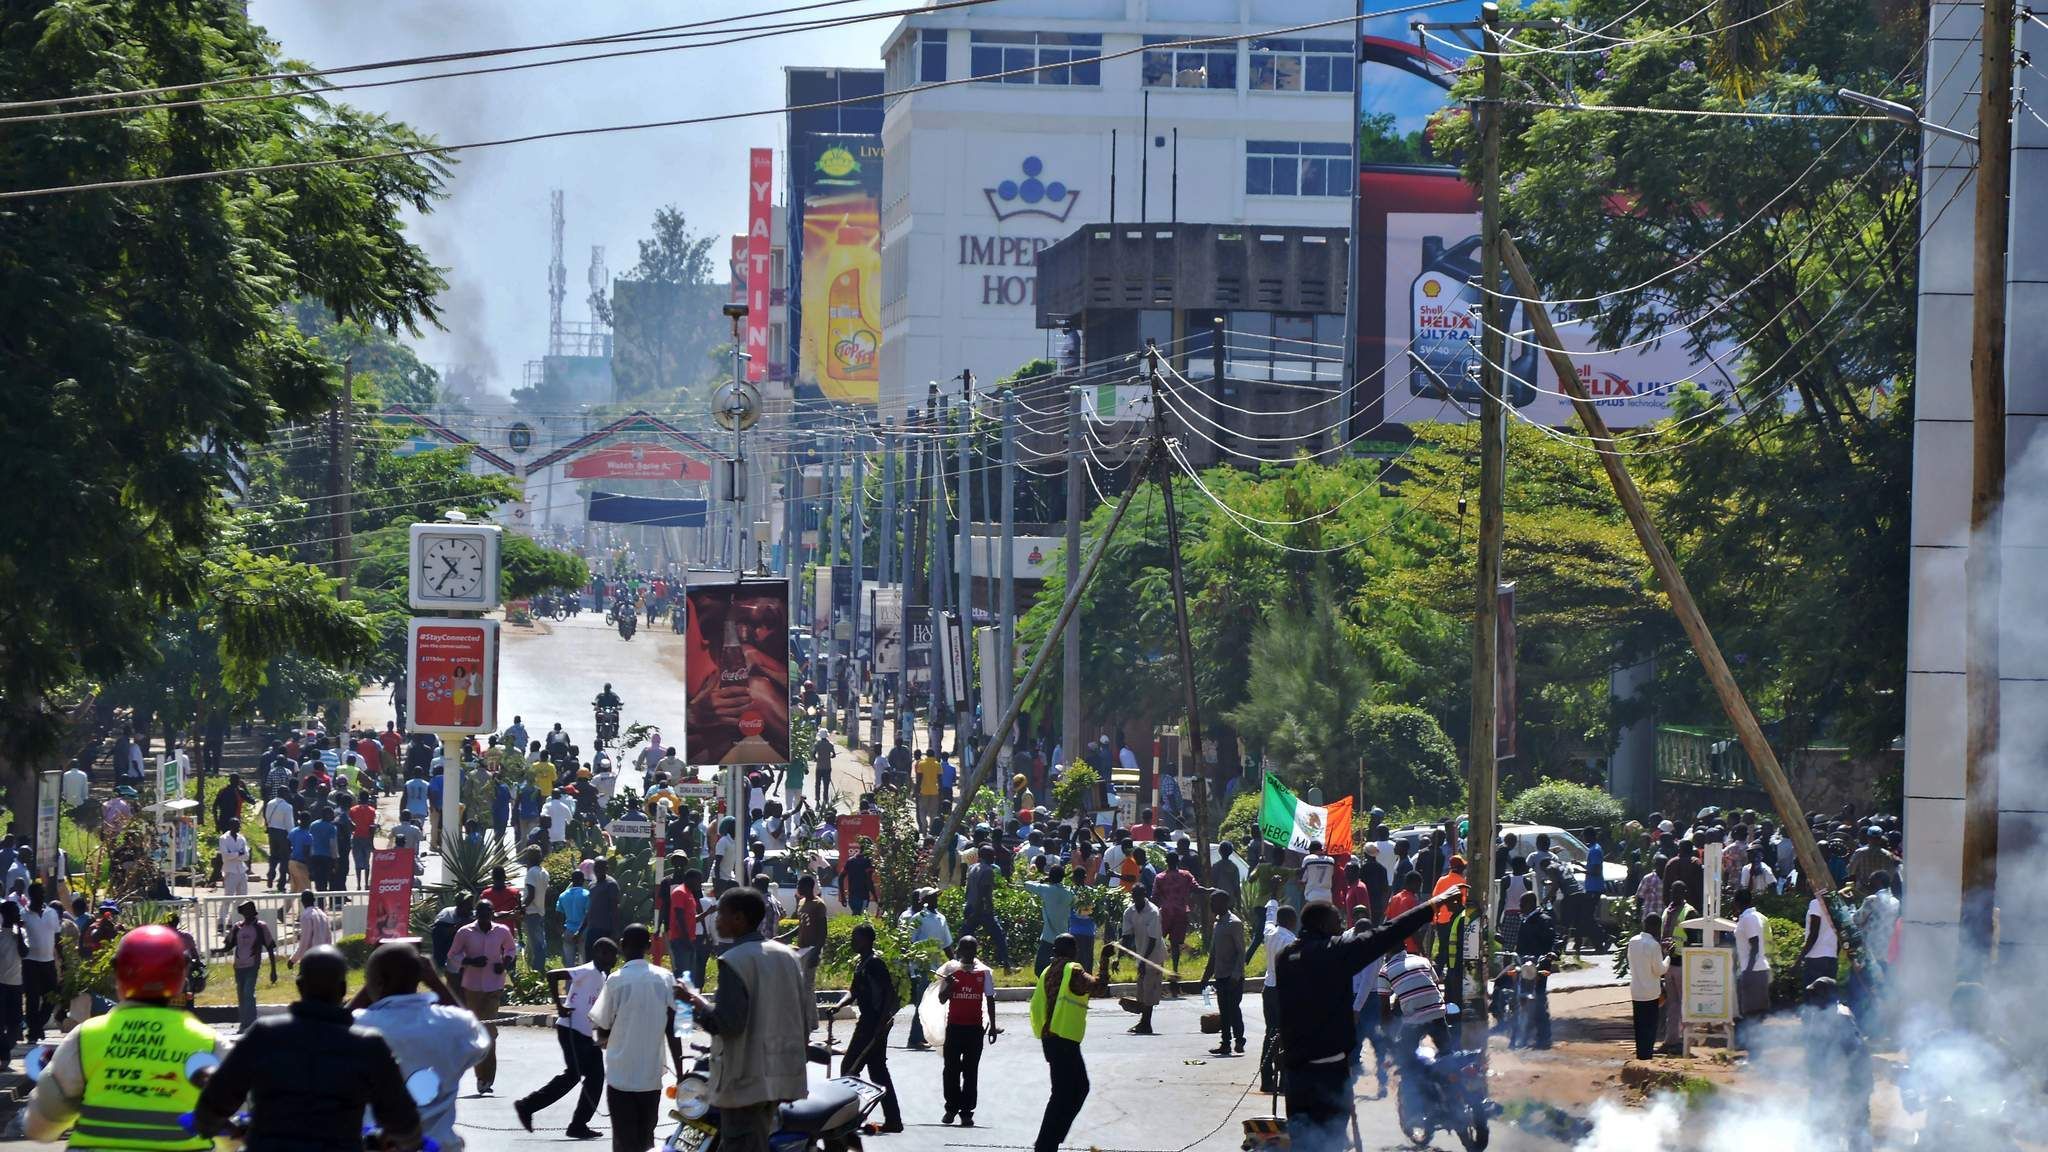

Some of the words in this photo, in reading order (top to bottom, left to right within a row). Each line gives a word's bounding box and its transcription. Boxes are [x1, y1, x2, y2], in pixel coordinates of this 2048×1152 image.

[958, 236, 1060, 267] IMPER
[750, 181, 770, 346] YATIN
[982, 275, 1037, 306] HOT
[1420, 305, 1443, 314] Shell
[1420, 316, 1473, 329] HELIX
[1420, 330, 1470, 341] ULTRA
[1576, 364, 1591, 377] ell
[1637, 381, 1708, 397] ULTA
[1628, 399, 1667, 410] Technolog
[420, 633, 480, 642] #StayConnected
[1294, 836, 1310, 851] MU
[379, 884, 401, 894] good
[121, 1020, 162, 1032] NIKO
[110, 1033, 166, 1046] NJIANI
[105, 1068, 142, 1080] TVS
